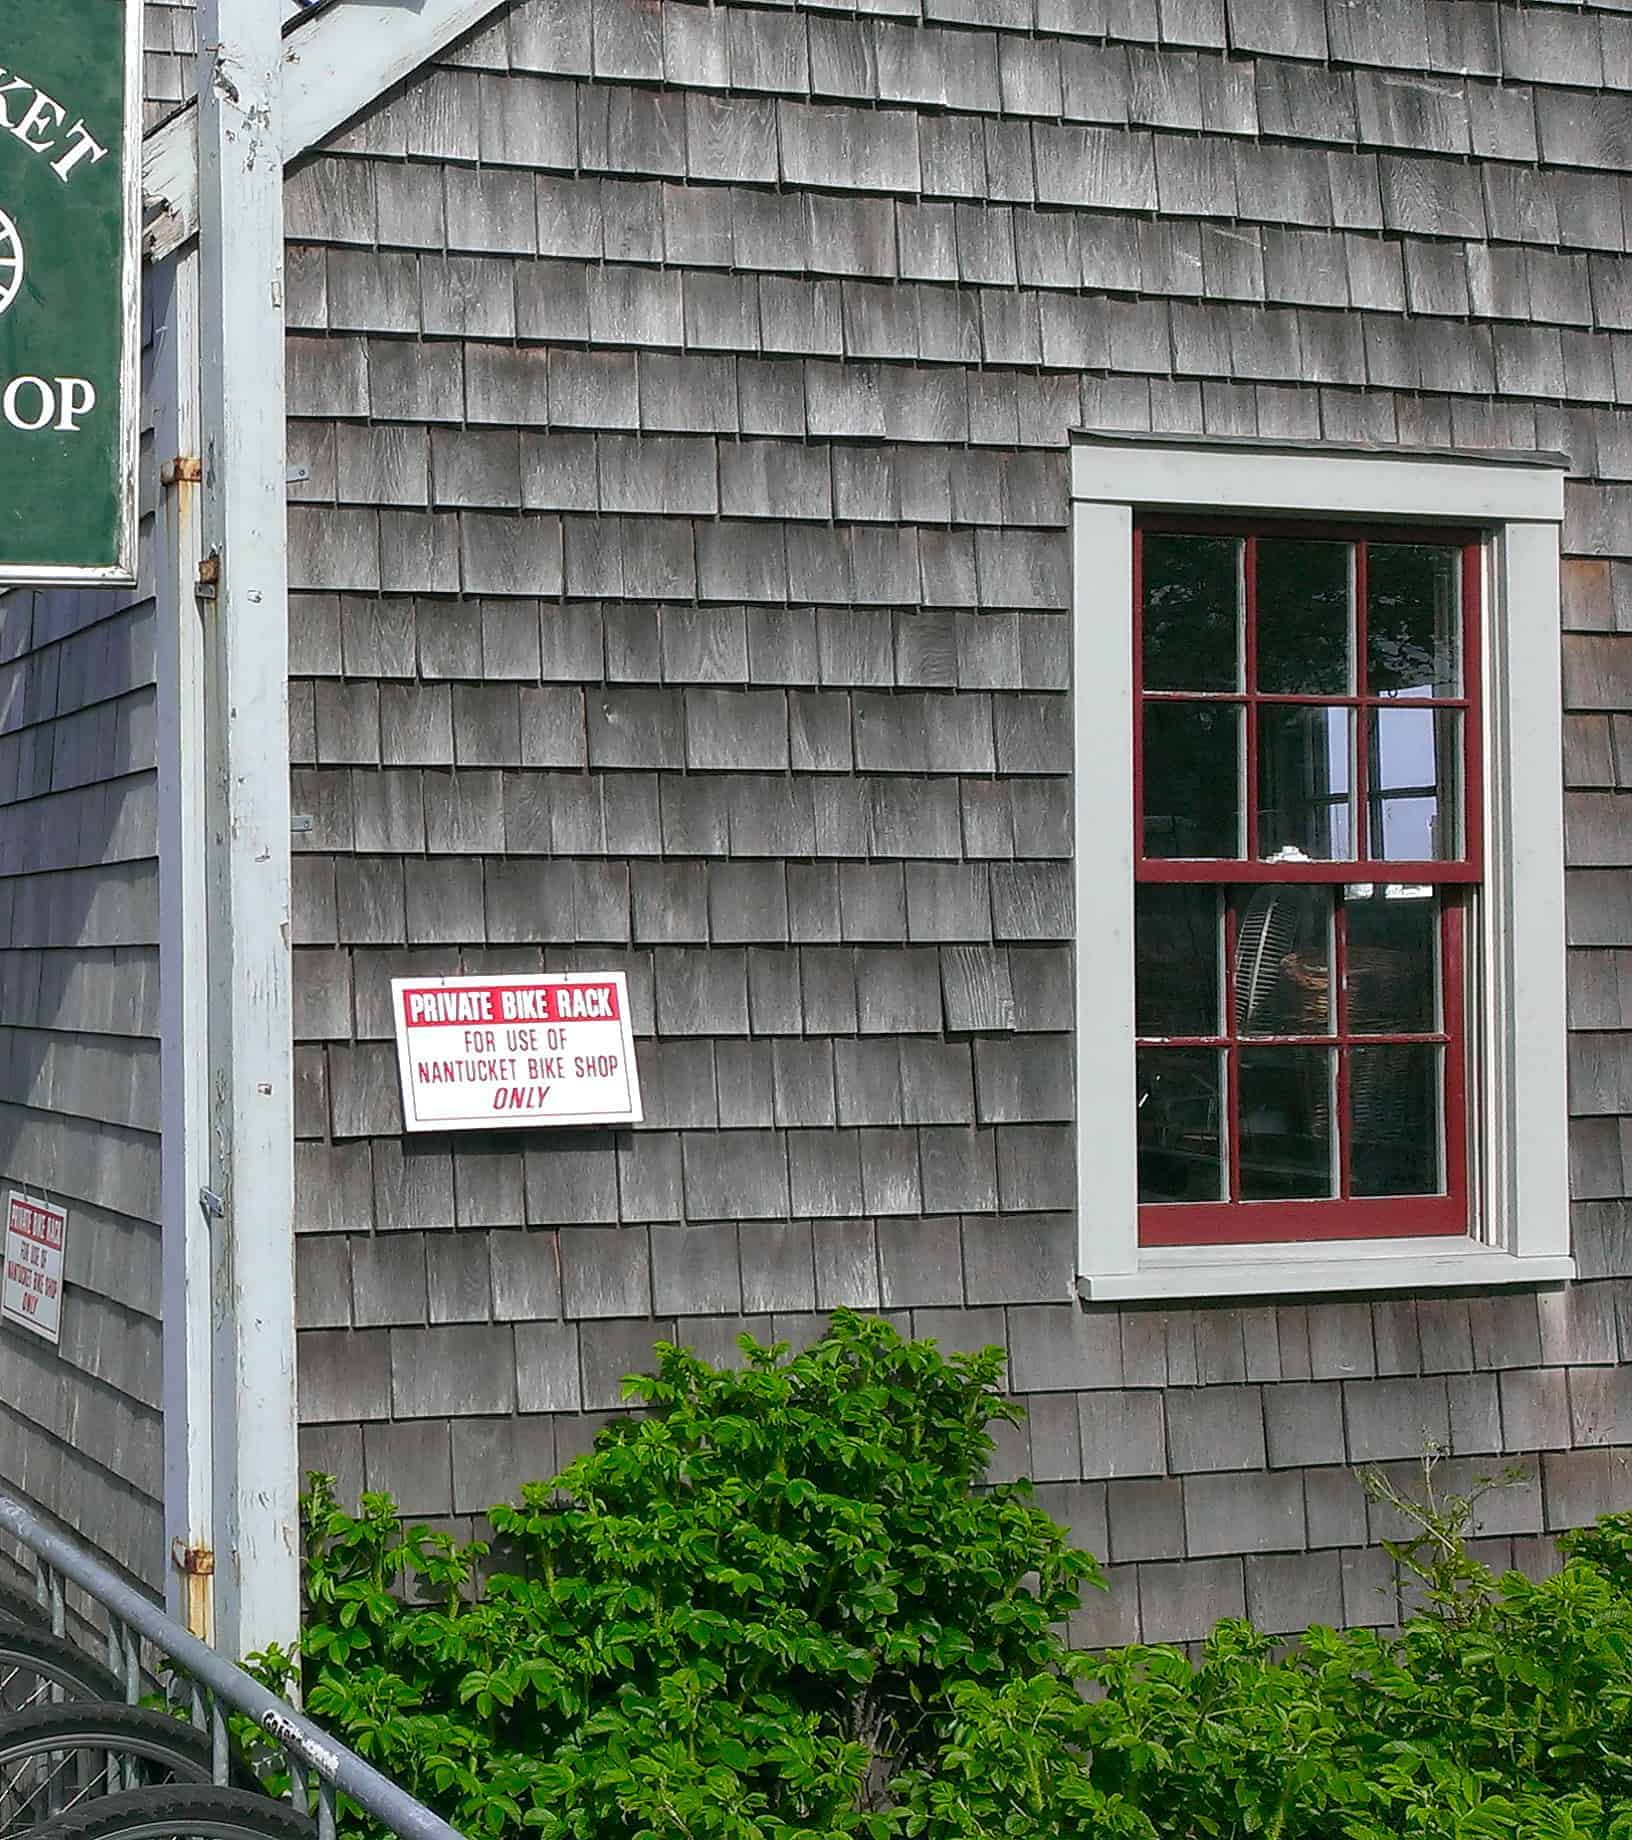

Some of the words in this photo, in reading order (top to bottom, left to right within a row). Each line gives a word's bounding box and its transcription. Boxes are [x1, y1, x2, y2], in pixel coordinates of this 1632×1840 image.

[409, 991, 494, 1023] PRIVATE
[501, 989, 549, 1020] BIKE
[555, 987, 613, 1018] RACK
[463, 1030, 497, 1054] FOR
[506, 1028, 539, 1053] USE
[546, 1027, 568, 1051] OF
[417, 1058, 517, 1084] NANTUCKET
[527, 1056, 566, 1080] BIKE
[573, 1054, 619, 1079] SHOP
[492, 1086, 550, 1110] ONLY
